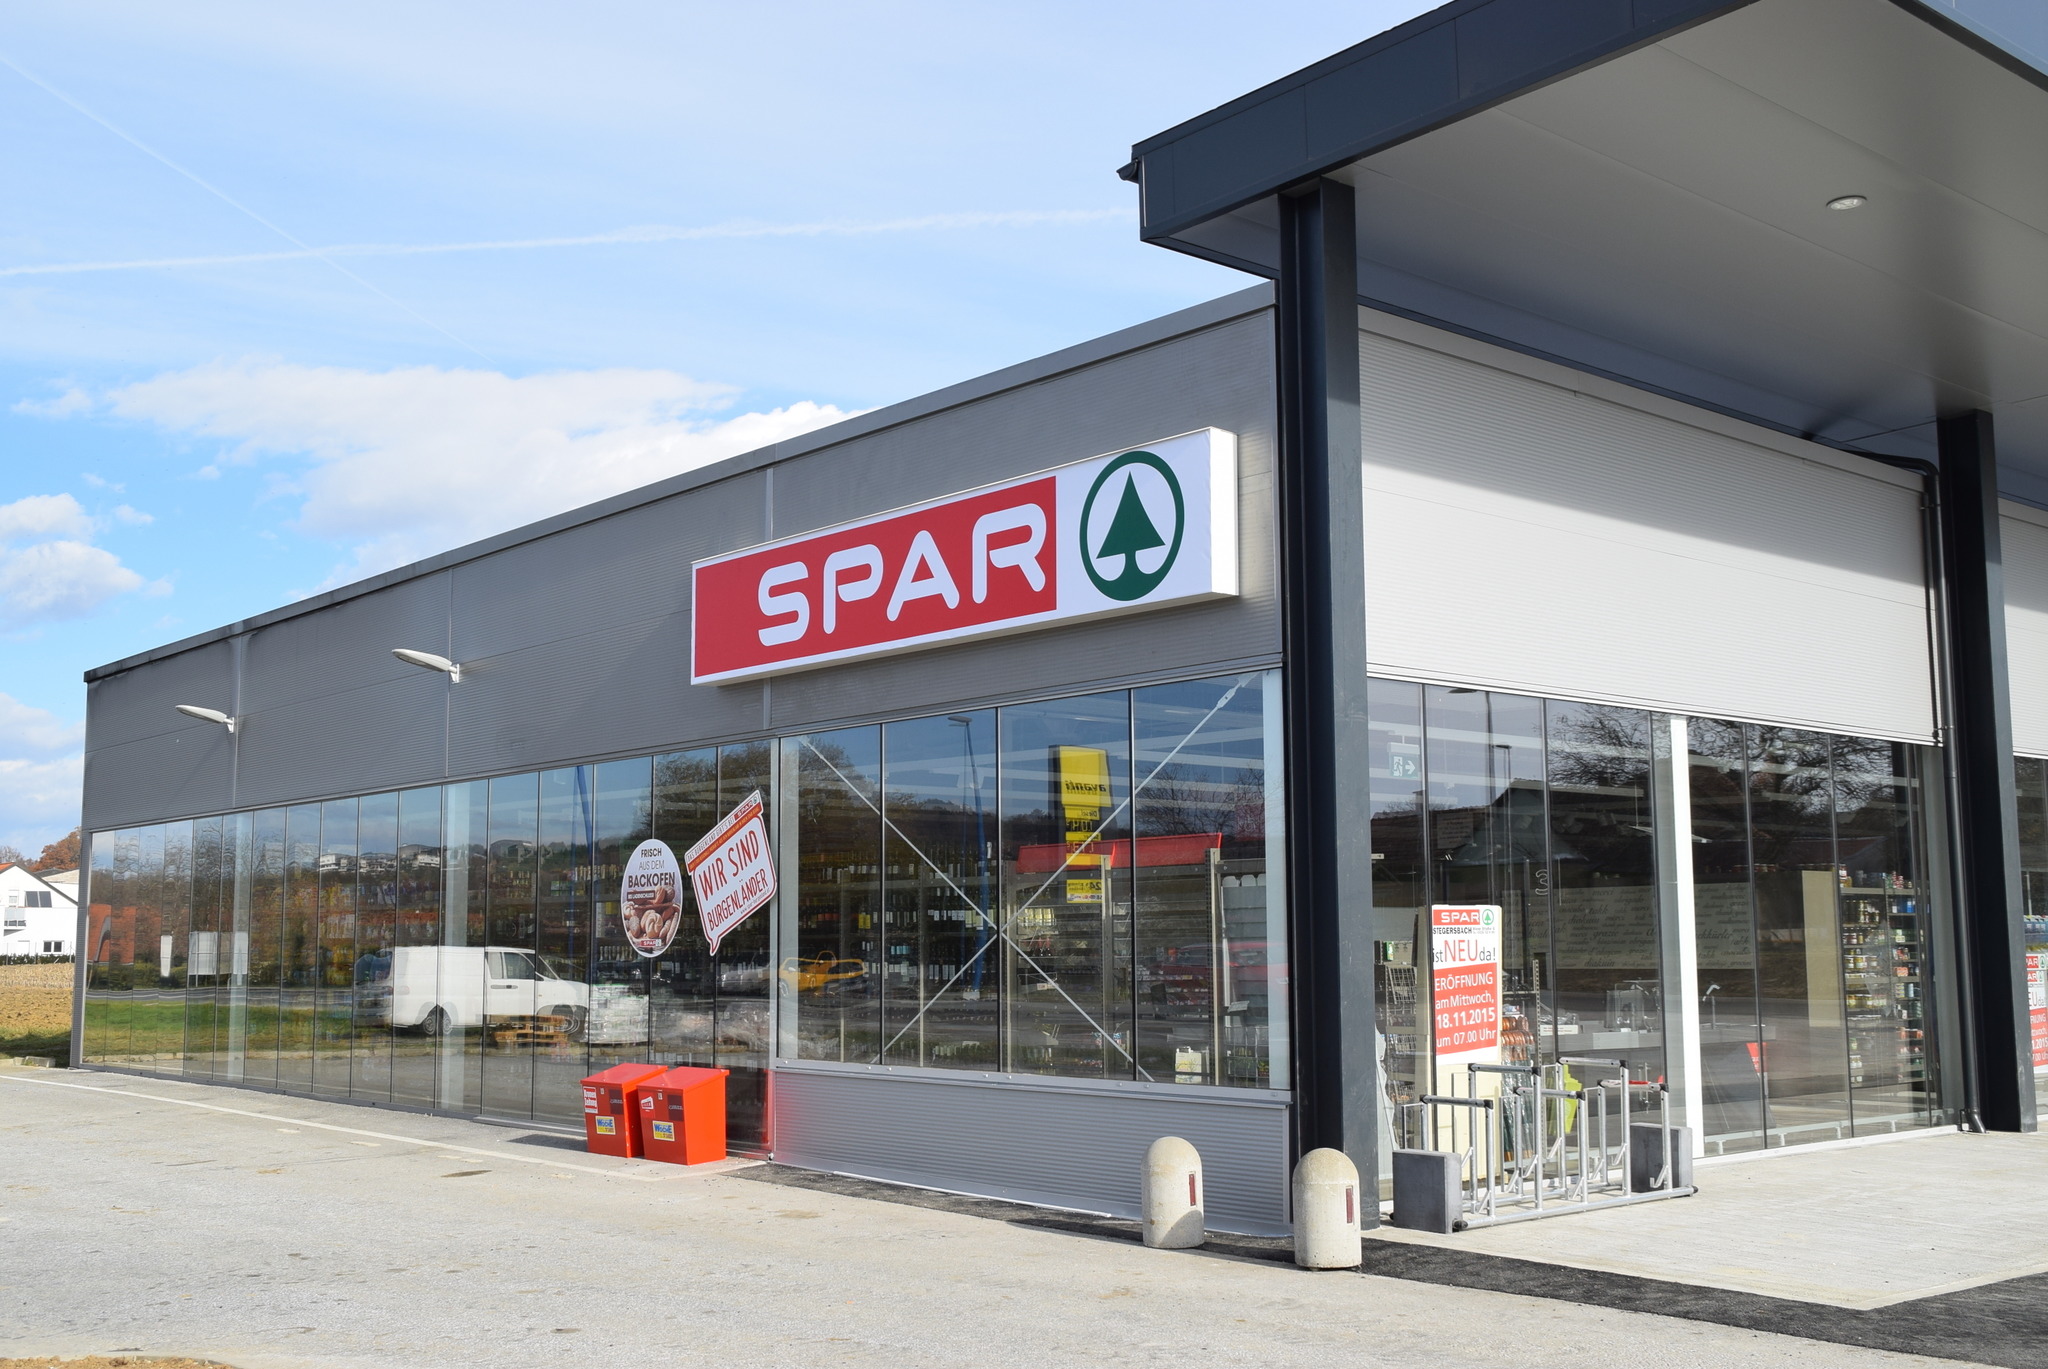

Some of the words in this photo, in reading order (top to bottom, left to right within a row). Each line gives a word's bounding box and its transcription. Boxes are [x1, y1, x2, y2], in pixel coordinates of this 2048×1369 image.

[758, 503, 1047, 646] SPAR
[737, 800, 753, 817] SPAR
[641, 847, 662, 858] FRISCH
[639, 861, 651, 871] AUS
[651, 860, 665, 870] DEM
[699, 857, 728, 901] WIR
[728, 830, 760, 877] SIND
[628, 872, 676, 889] BACKOFEN
[707, 868, 769, 932] BURGENLÄNDER
[1440, 912, 1480, 923] SPAR
[1433, 927, 1472, 935] STEGERSBACH
[1444, 939, 1478, 962] NEU
[1479, 946, 1496, 961] da!
[2026, 957, 2039, 966] AR
[1435, 972, 1493, 991] ERÖFFNUNG
[1435, 999, 1449, 1010] am
[1450, 990, 1494, 1008] Mittwoch,
[1437, 1007, 1496, 1029] 18.11.2015
[1436, 1036, 1451, 1048] um
[1453, 1030, 1477, 1045] 07.00
[1479, 1028, 1497, 1041] Uhr
